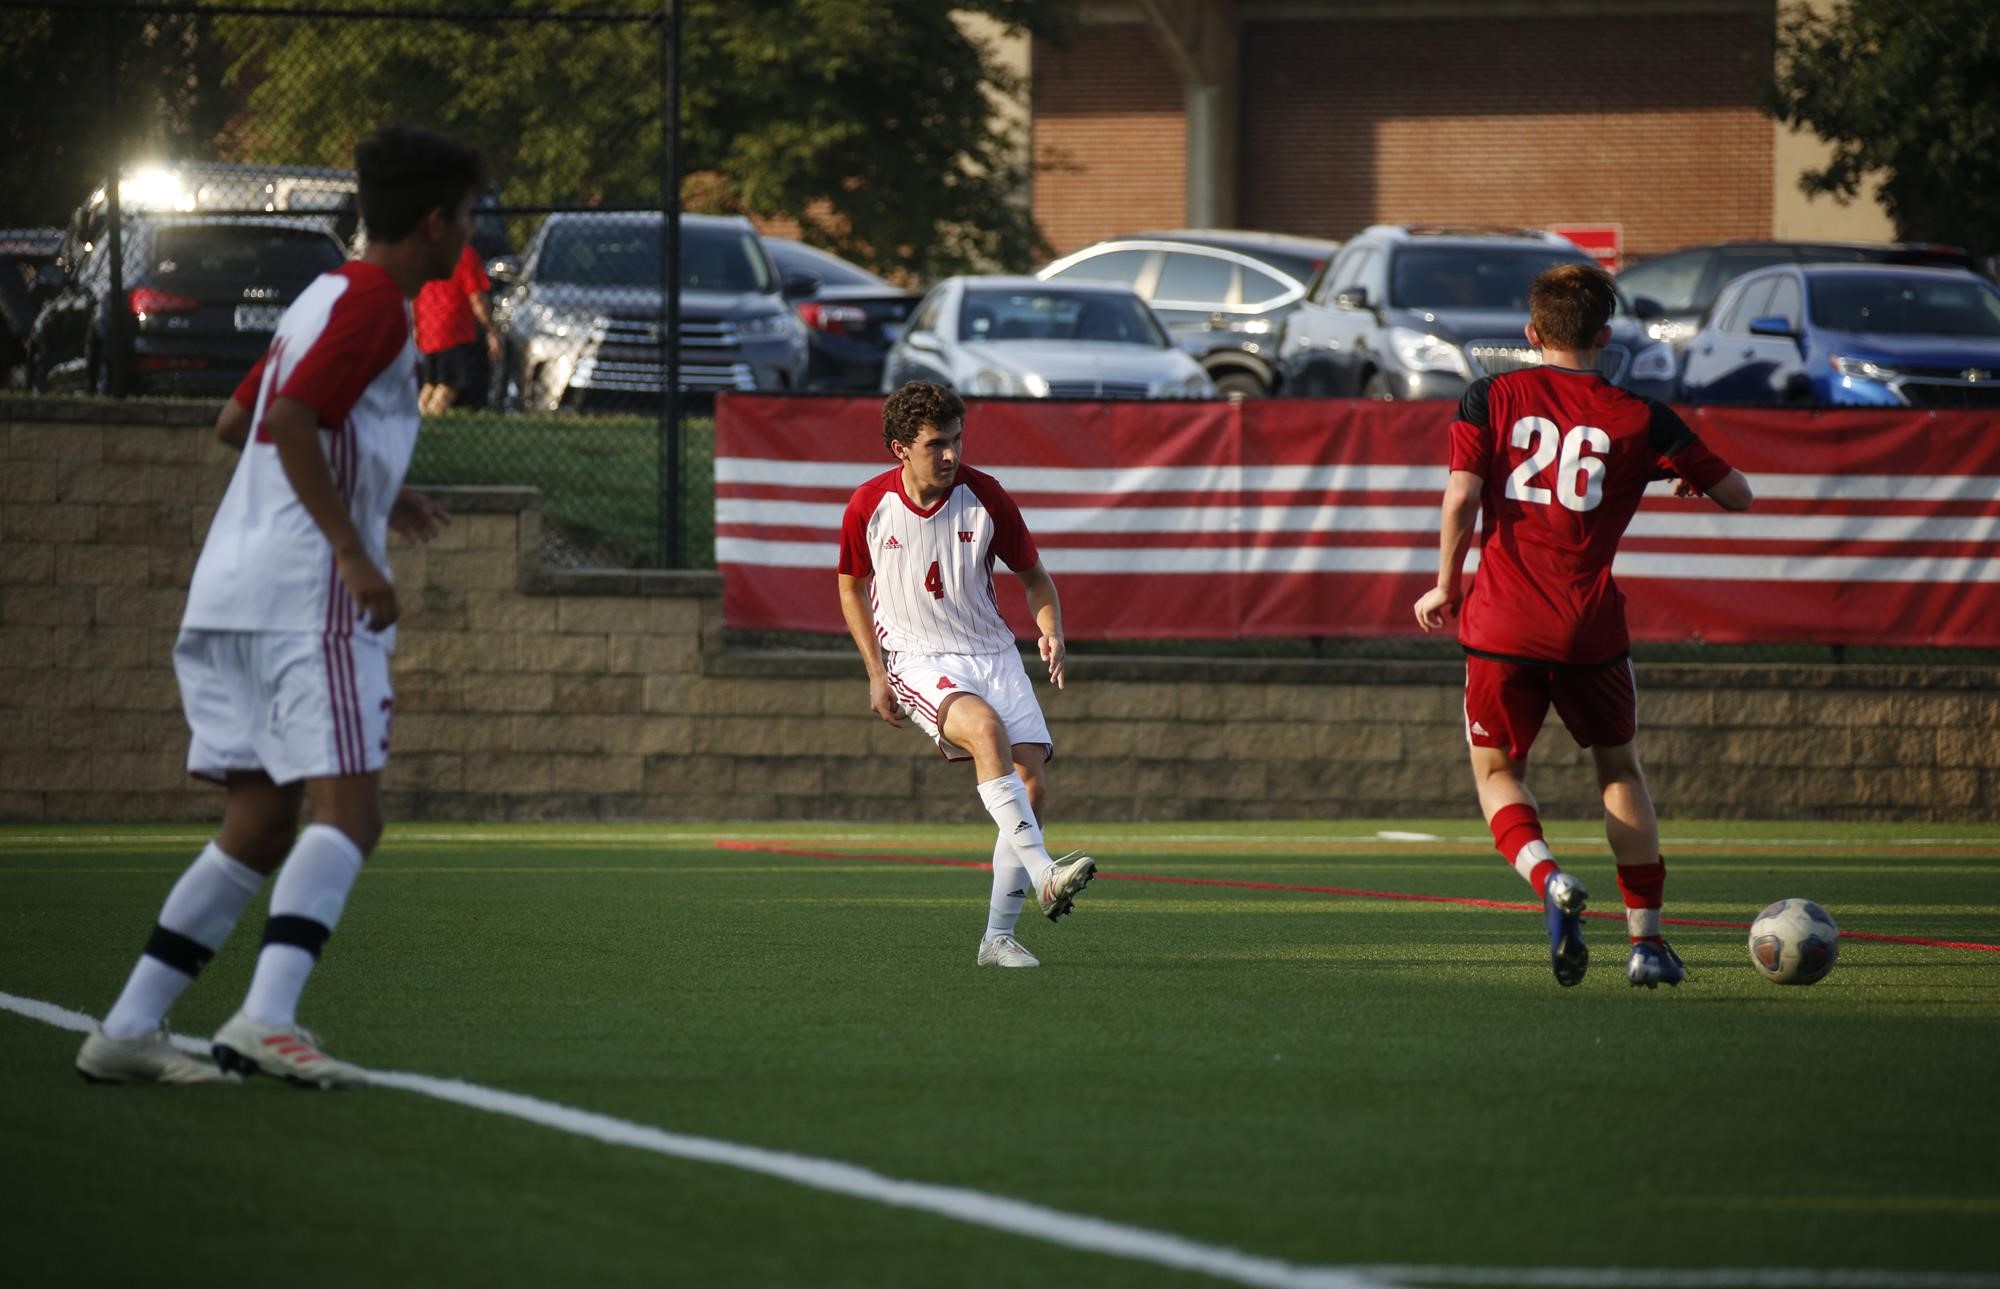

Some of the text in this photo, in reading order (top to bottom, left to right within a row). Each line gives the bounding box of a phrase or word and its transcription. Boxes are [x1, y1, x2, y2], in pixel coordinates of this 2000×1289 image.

[1504, 415, 1611, 512] 26
[924, 560, 945, 600] 4
[936, 675, 958, 691] 4
